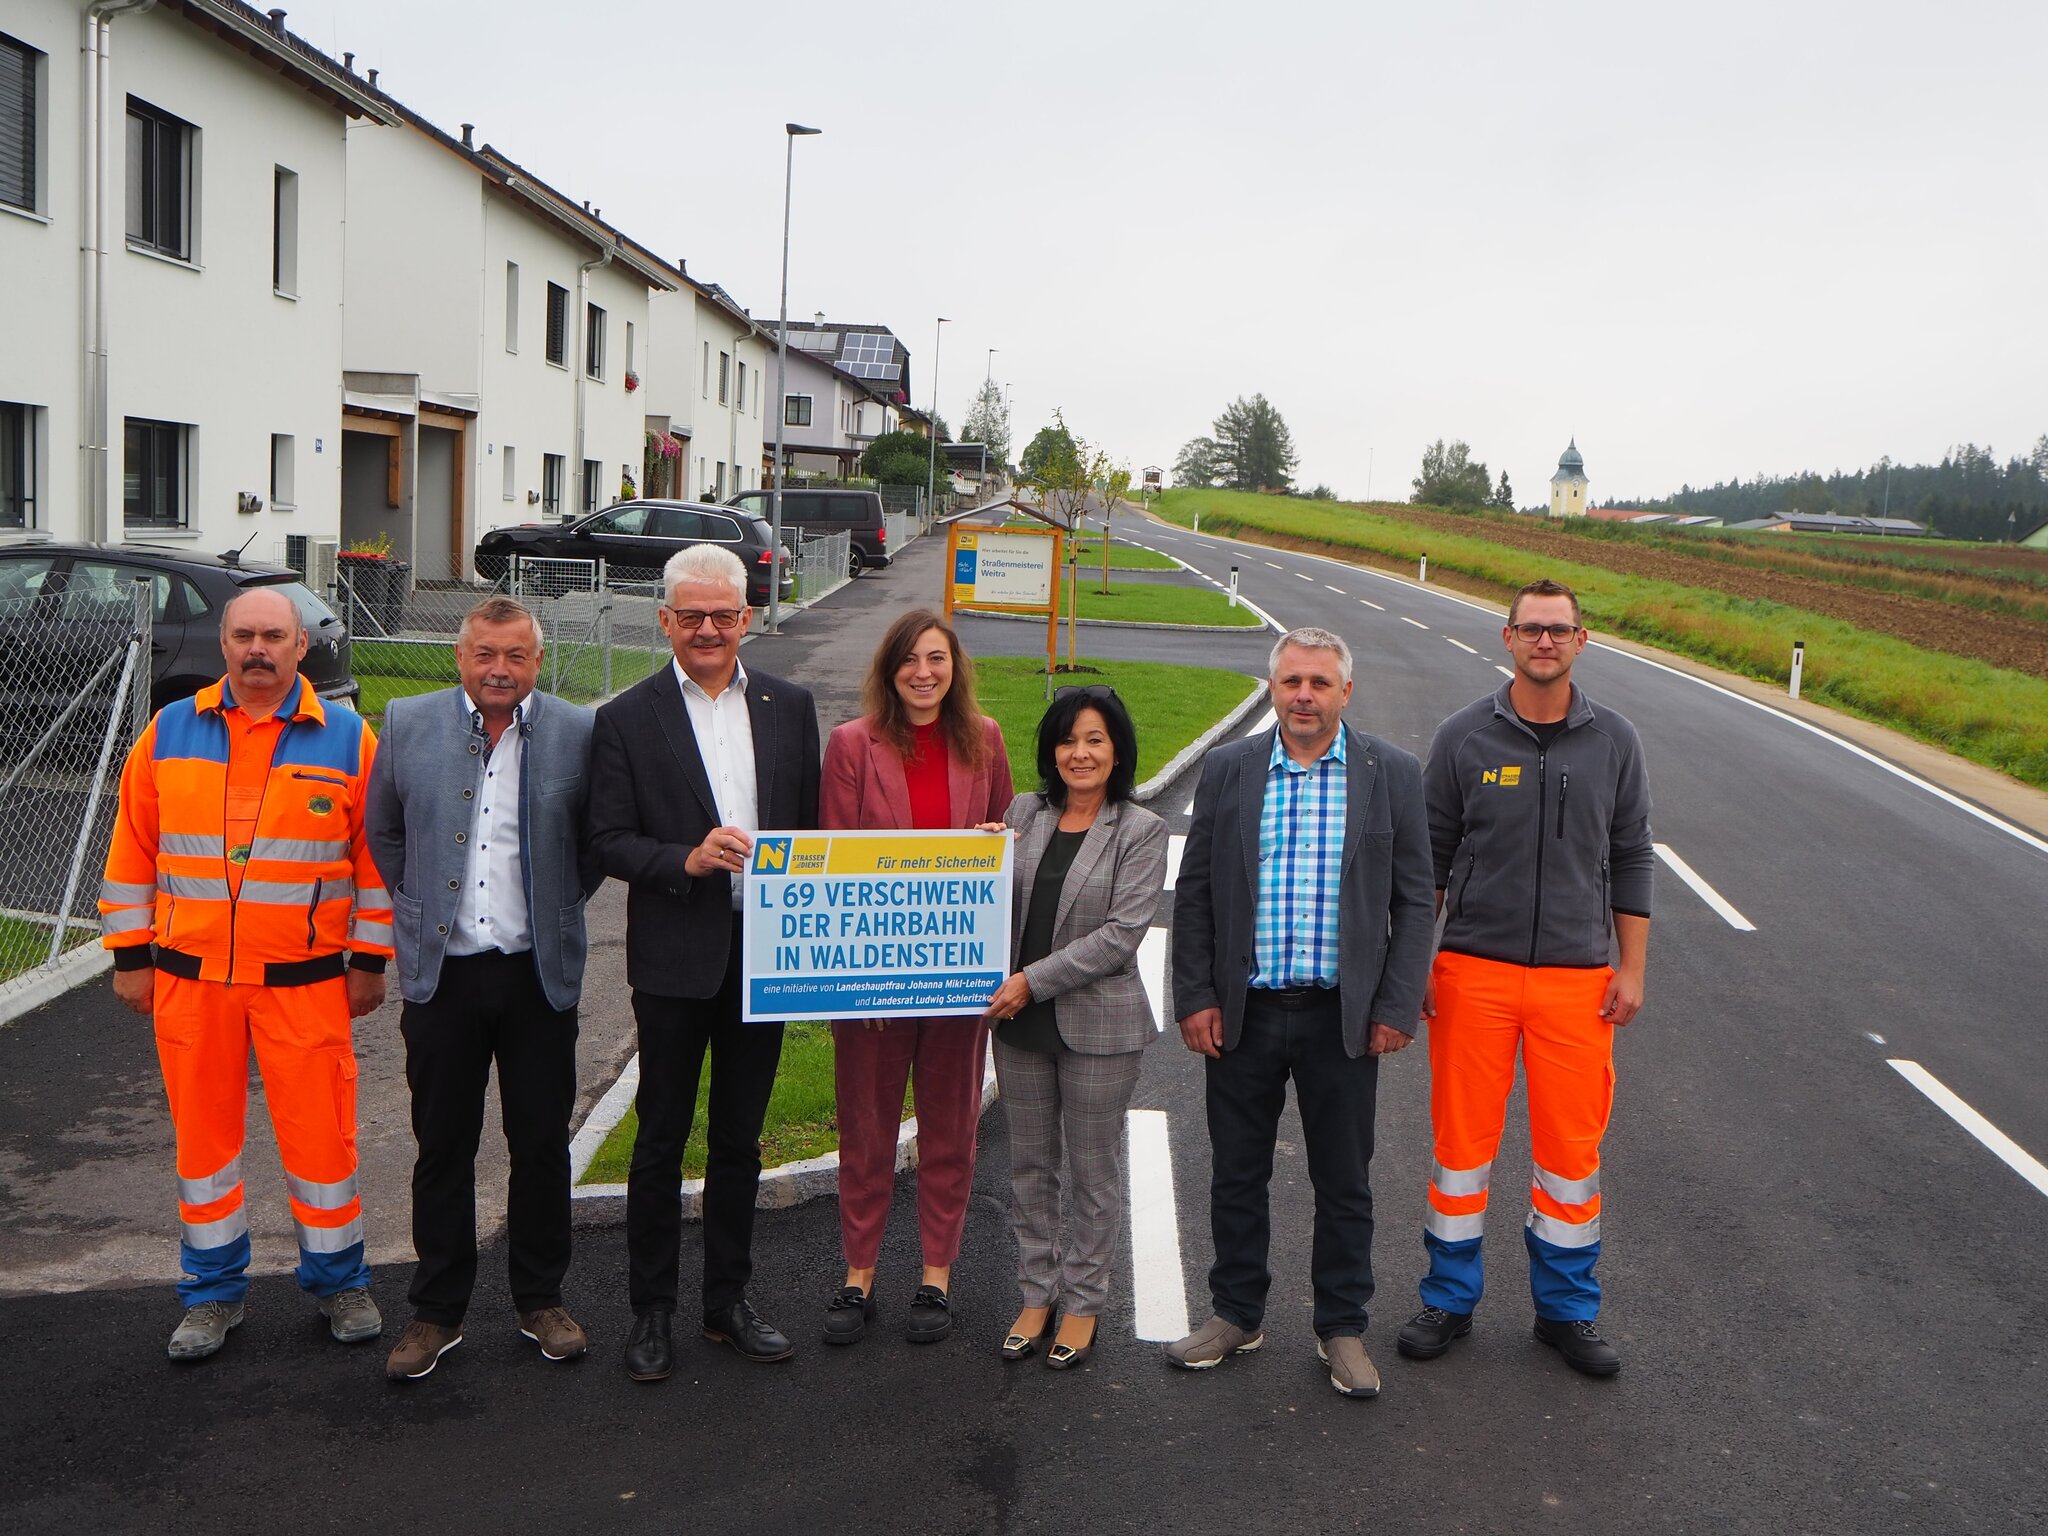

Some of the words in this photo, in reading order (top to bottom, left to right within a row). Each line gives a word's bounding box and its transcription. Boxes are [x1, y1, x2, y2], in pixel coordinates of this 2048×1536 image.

[981, 559, 1044, 570] Straßenmeisterei
[981, 569, 1006, 578] Weitra
[1482, 770, 1497, 784] N
[756, 843, 785, 869] N
[792, 854, 826, 862] STRASSEN
[877, 857, 896, 870] Für
[900, 857, 932, 869] mehr
[935, 856, 996, 869] Sicherheit
[800, 861, 825, 869] DIENST
[760, 883, 774, 909] L
[782, 882, 815, 908] 69
[825, 880, 995, 907] VERSCHWENK
[781, 913, 830, 938] DER
[840, 911, 975, 937] FAHRBAHN
[776, 946, 800, 970] IN
[810, 941, 984, 969] WALDENSTEIN
[763, 985, 781, 994] eine
[782, 983, 818, 993] Initiative
[820, 984, 834, 992] von
[836, 981, 906, 992] Landeshauptfrau
[907, 980, 943, 990] Johanna
[945, 979, 995, 989] Mikl-Leitner
[855, 997, 870, 1007] und
[872, 995, 914, 1006] Landesrat
[915, 994, 944, 1006] Ludwig
